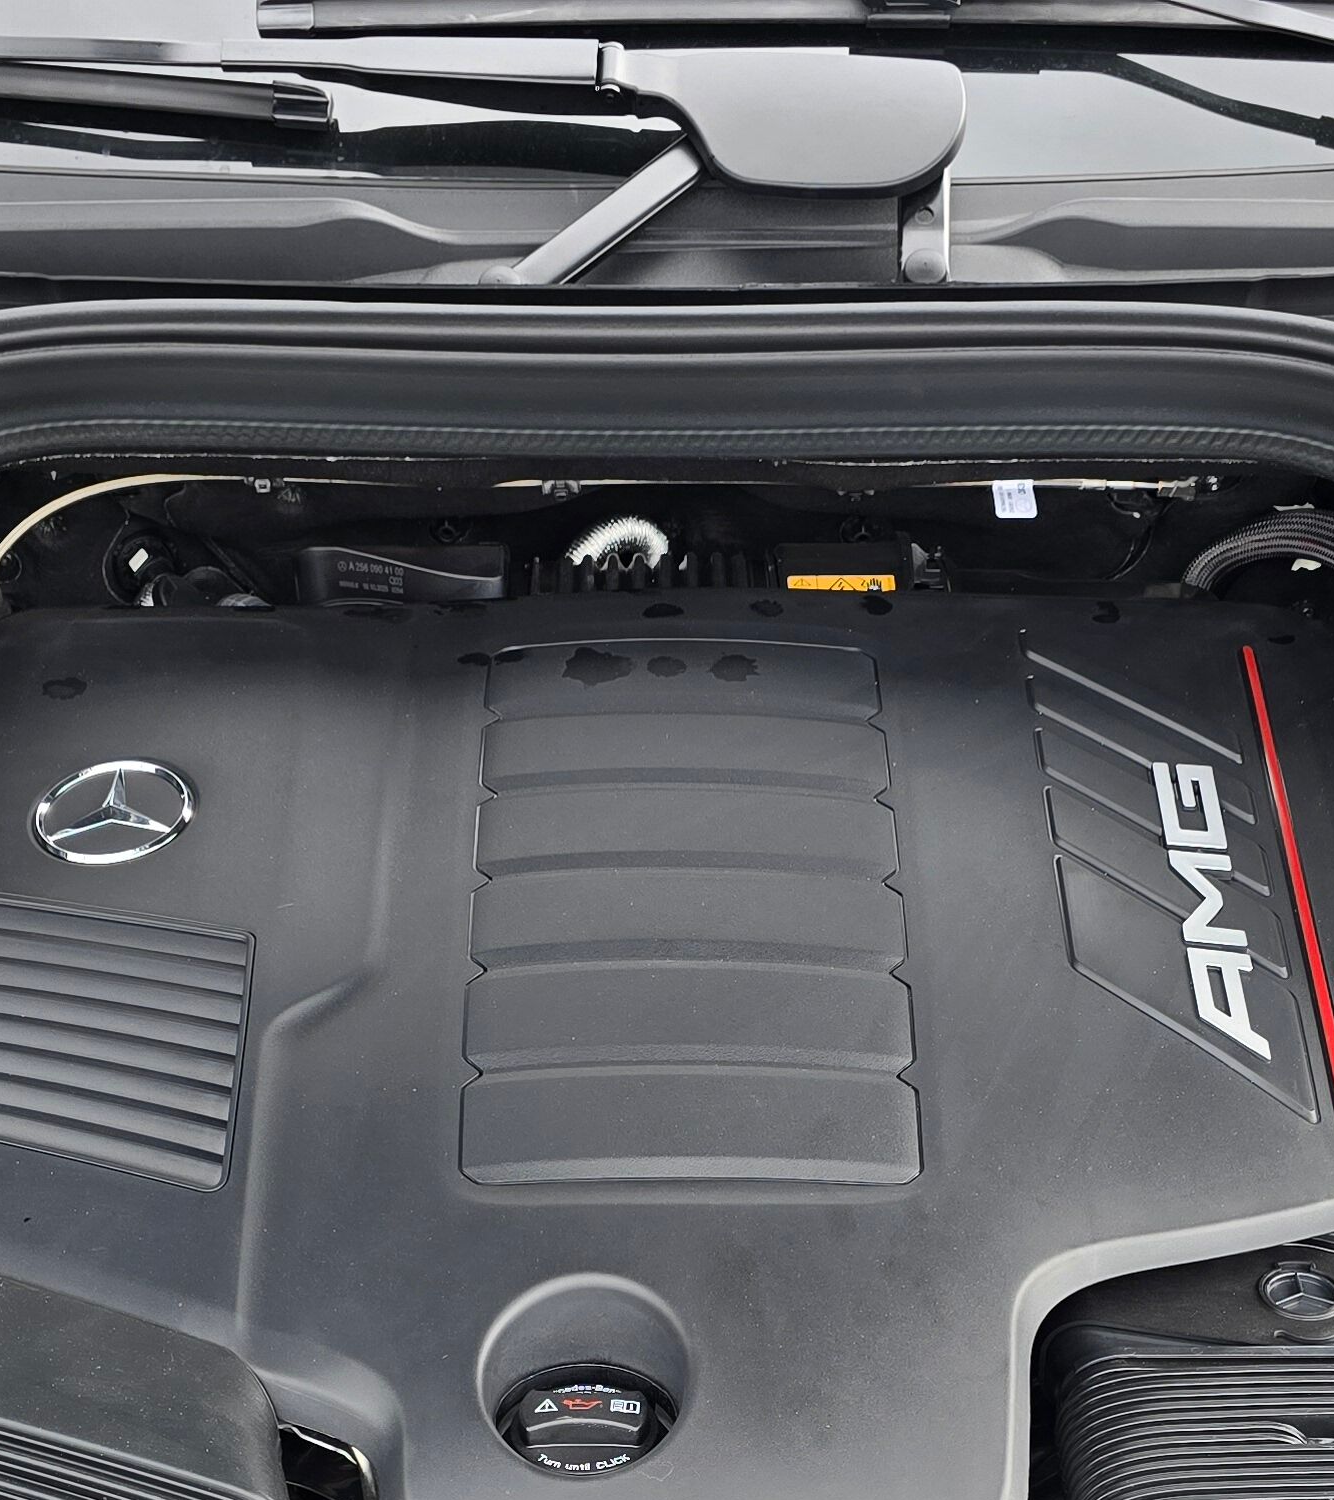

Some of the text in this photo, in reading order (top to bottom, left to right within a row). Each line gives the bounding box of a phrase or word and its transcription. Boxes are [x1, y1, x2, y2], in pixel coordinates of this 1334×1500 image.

[1152, 762, 1273, 1062] AMG
[537, 1453, 631, 1471] Turn until CLICK
